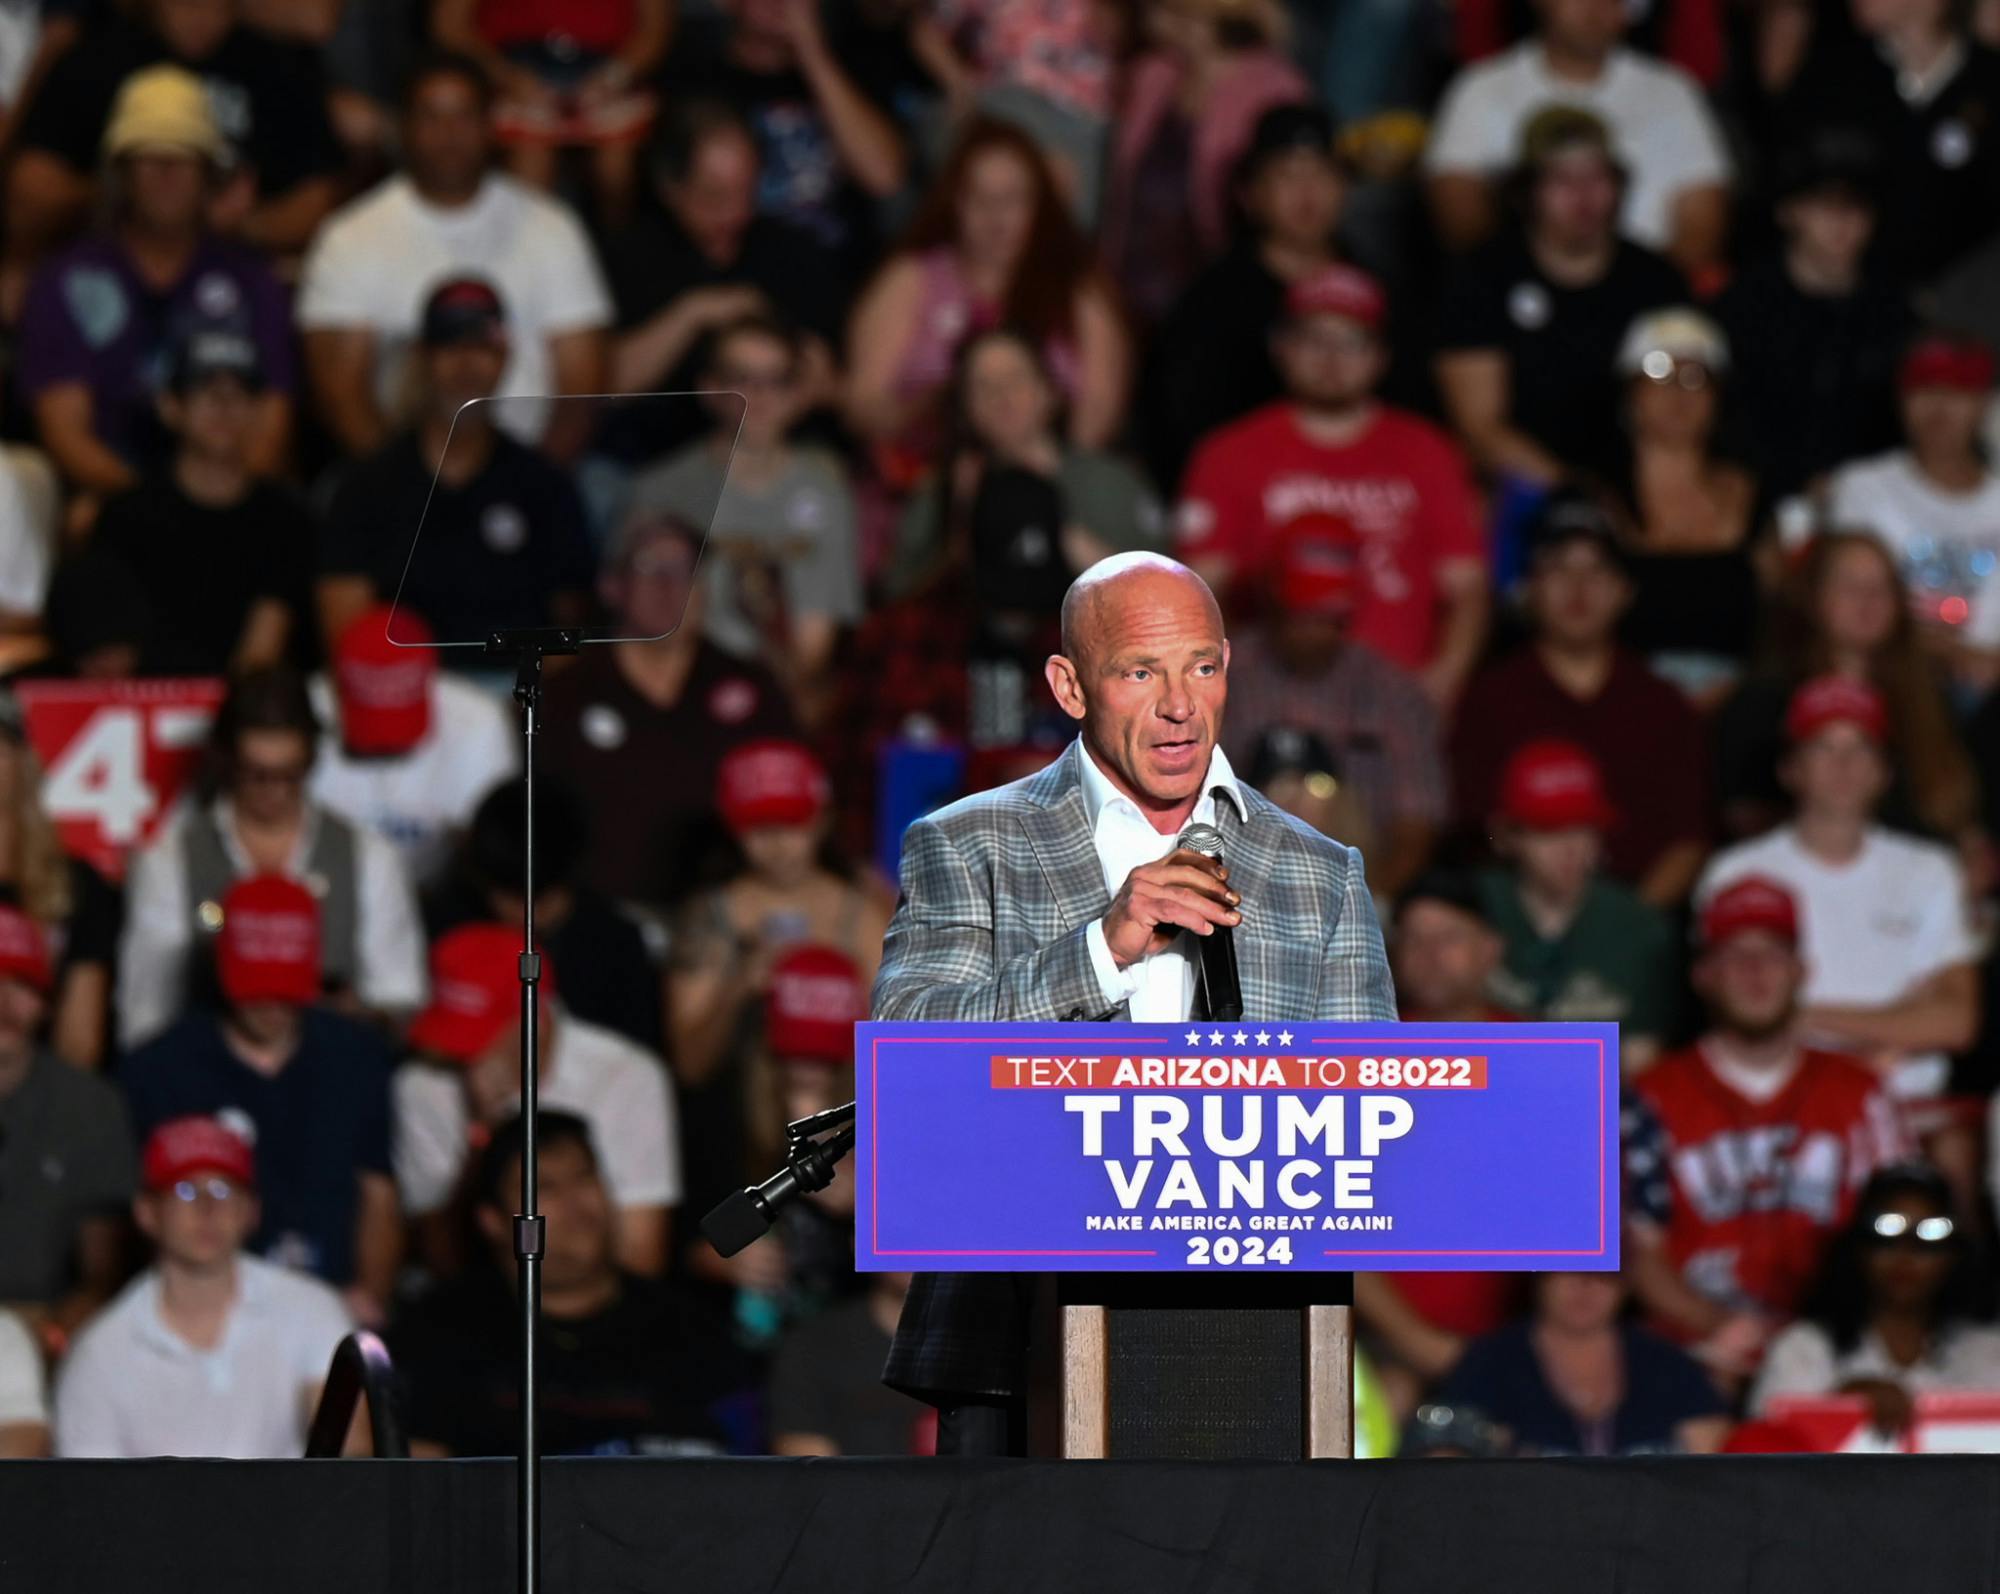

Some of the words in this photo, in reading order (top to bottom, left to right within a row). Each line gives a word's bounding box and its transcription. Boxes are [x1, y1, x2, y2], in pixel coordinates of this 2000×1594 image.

[1007, 1058, 1101, 1086] TEXT
[1112, 1058, 1286, 1087] ARIZONA
[1297, 1058, 1346, 1087] TO
[1357, 1058, 1472, 1087] 88022
[1064, 1095, 1414, 1158] TRUMP
[1104, 1159, 1374, 1210] VANCE
[1086, 1215, 1143, 1231] MAKE
[1149, 1215, 1242, 1231] AMERICA
[1248, 1215, 1315, 1231] GREAT
[1321, 1215, 1393, 1231] AGAIN!
[1186, 1236, 1294, 1266] 2024
